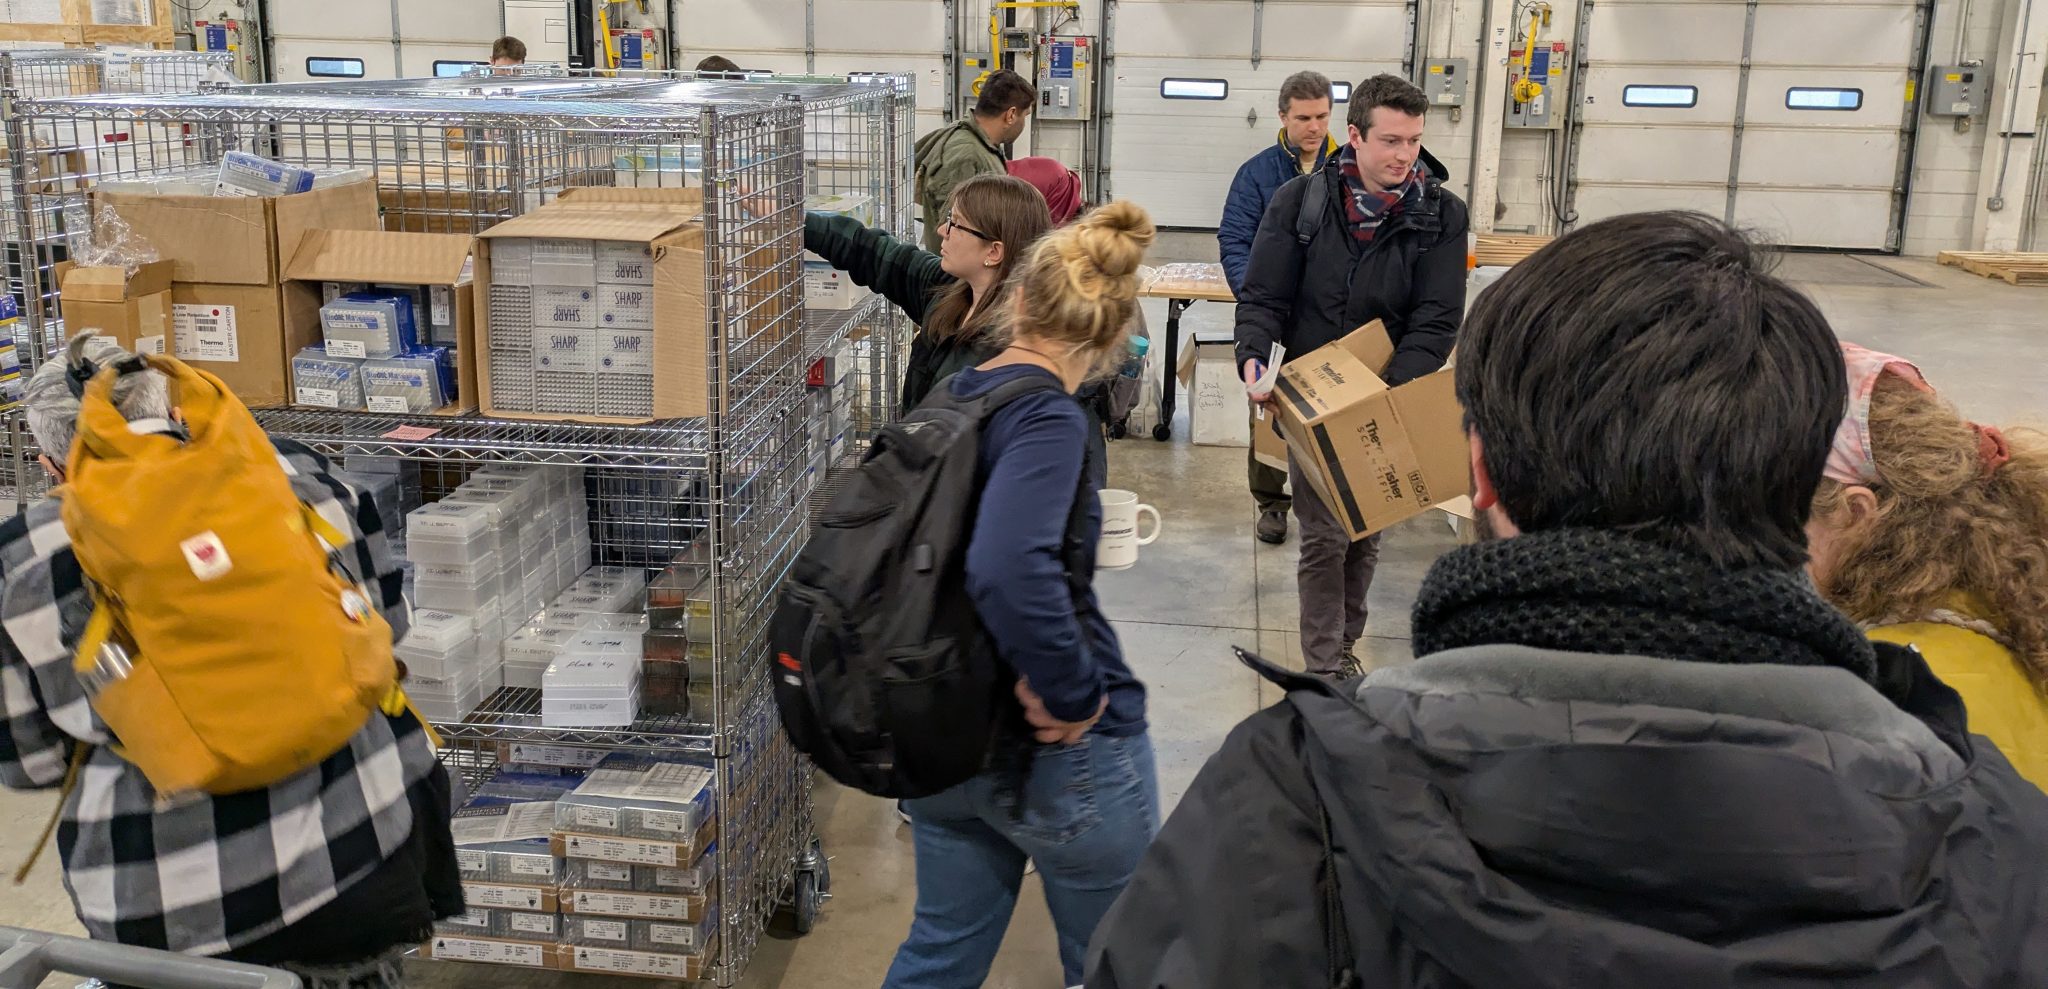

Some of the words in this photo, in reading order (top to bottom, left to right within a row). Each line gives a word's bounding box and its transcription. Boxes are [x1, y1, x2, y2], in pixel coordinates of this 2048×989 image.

[615, 261, 643, 279] SHARP
[614, 291, 642, 309] SHARP
[225, 306, 233, 332] CARTON
[553, 305, 581, 322] SHARP
[551, 335, 578, 352] SHARP
[613, 335, 641, 353] SHARP
